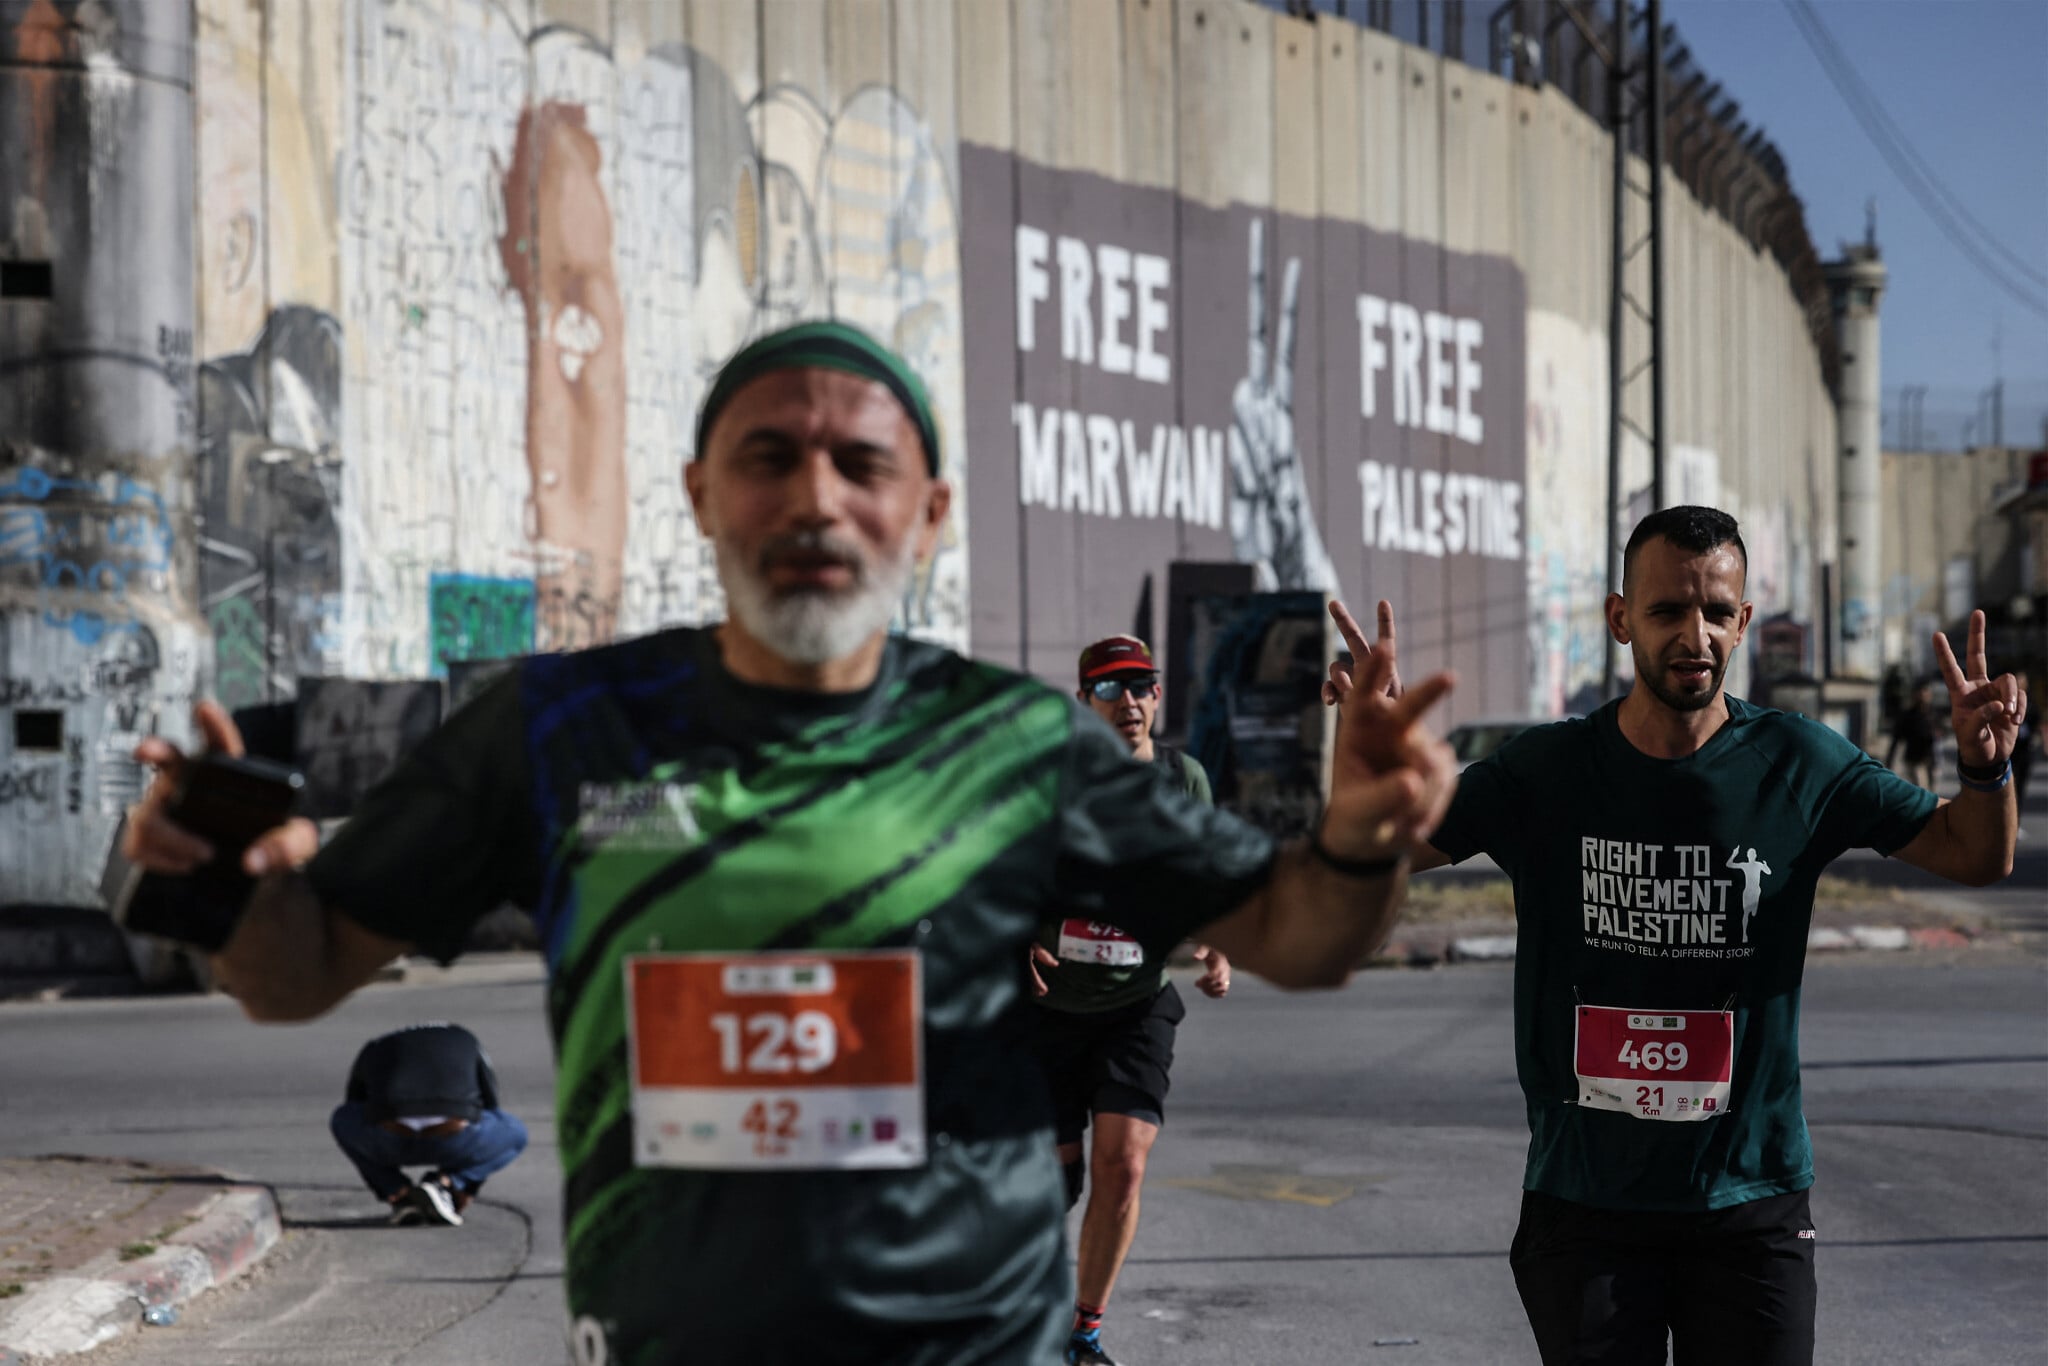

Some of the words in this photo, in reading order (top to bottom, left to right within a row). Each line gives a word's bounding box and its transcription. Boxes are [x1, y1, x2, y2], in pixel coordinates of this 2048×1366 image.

[1015, 224, 1171, 384] FREE
[1357, 294, 1484, 445] FREE
[1012, 402, 1223, 530] MARWAN
[1359, 460, 1522, 560] PALESTINE
[1582, 836, 1663, 877] RIGHT
[1674, 845, 1711, 877] TO
[1582, 869, 1732, 912] MOVEMENT
[1583, 903, 1727, 944] PALESTINE
[1584, 936, 1600, 948] WE
[1601, 939, 1621, 950] RUN
[1623, 942, 1636, 953] TO
[1638, 946, 1658, 957] TELL
[1660, 949, 1669, 958] A
[1671, 949, 1723, 959] DIFFERENT
[1726, 947, 1755, 959] STORY
[711, 1011, 837, 1073] 129
[1617, 1040, 1689, 1071] 469
[1636, 1086, 1664, 1107] 21
[1642, 1106, 1661, 1116] Km
[740, 1099, 800, 1139] 42
